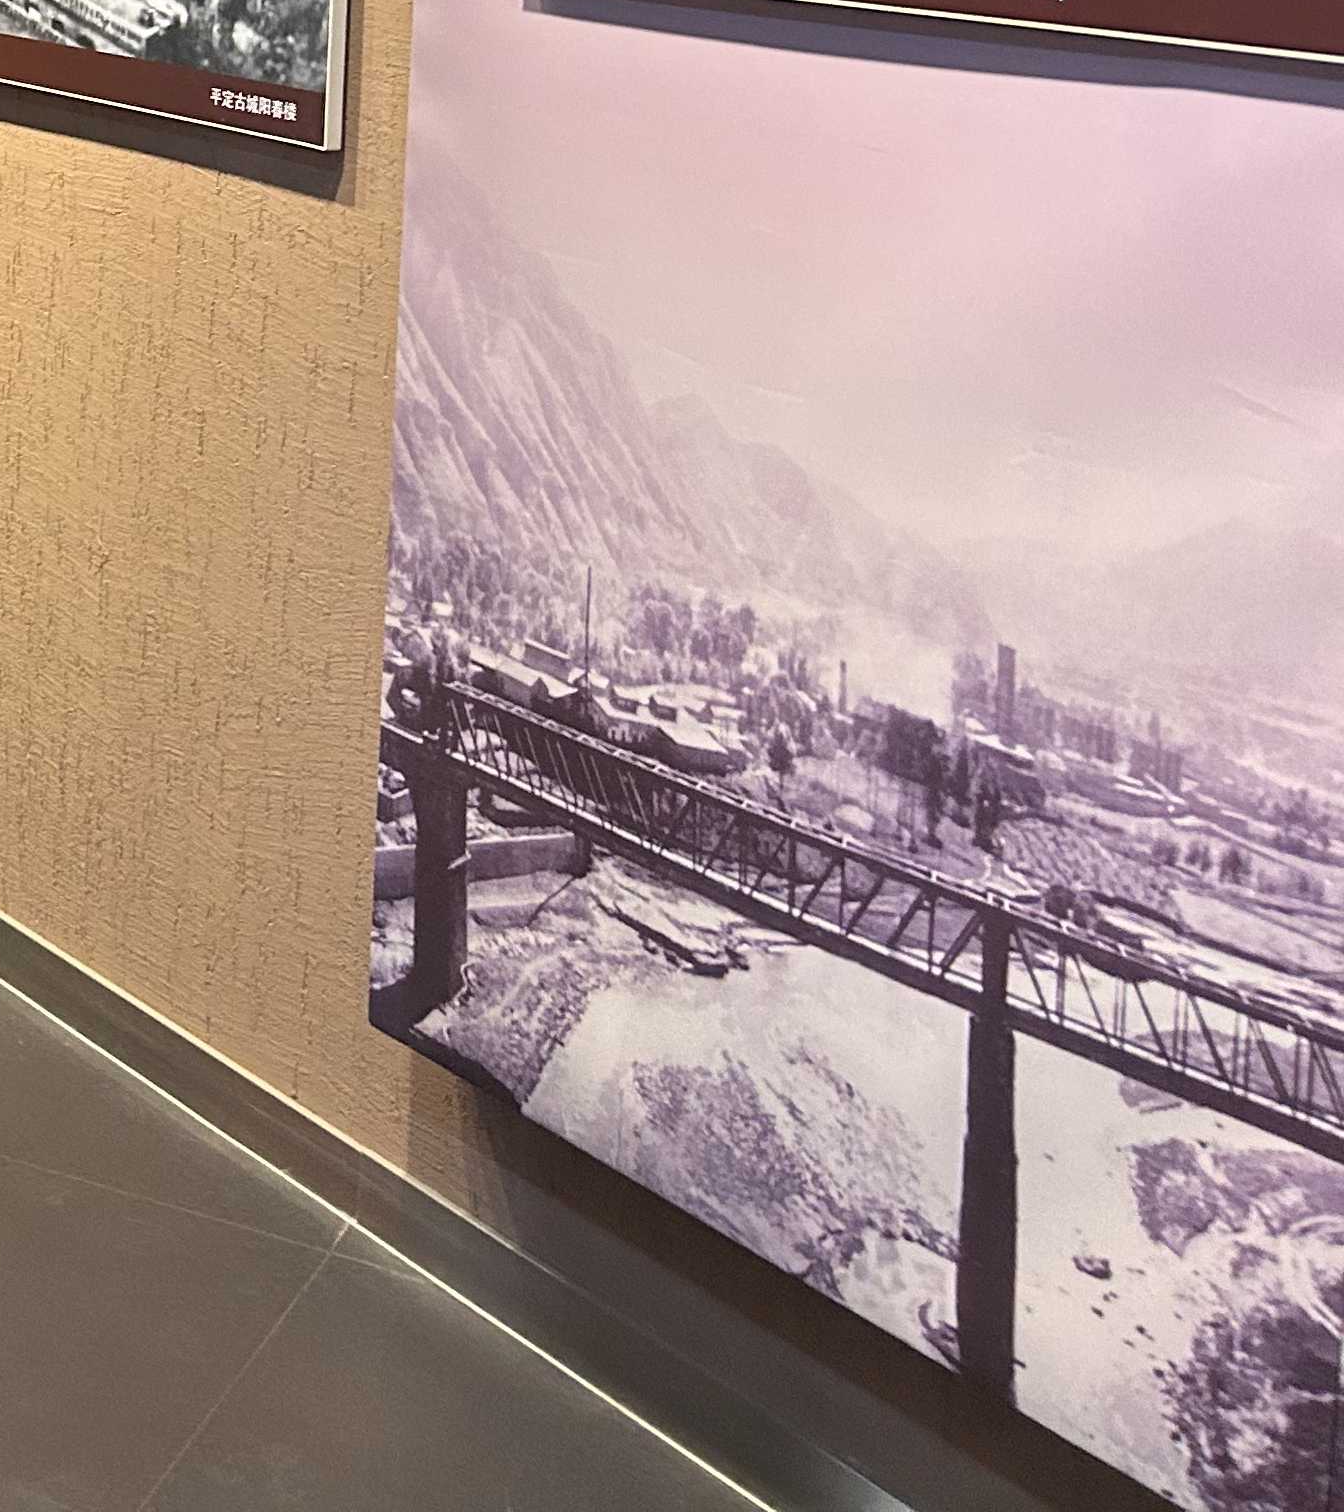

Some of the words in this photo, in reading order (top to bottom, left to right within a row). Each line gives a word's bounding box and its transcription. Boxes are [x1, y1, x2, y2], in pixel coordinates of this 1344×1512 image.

[210, 87, 297, 122] 平定古城阳春楼
